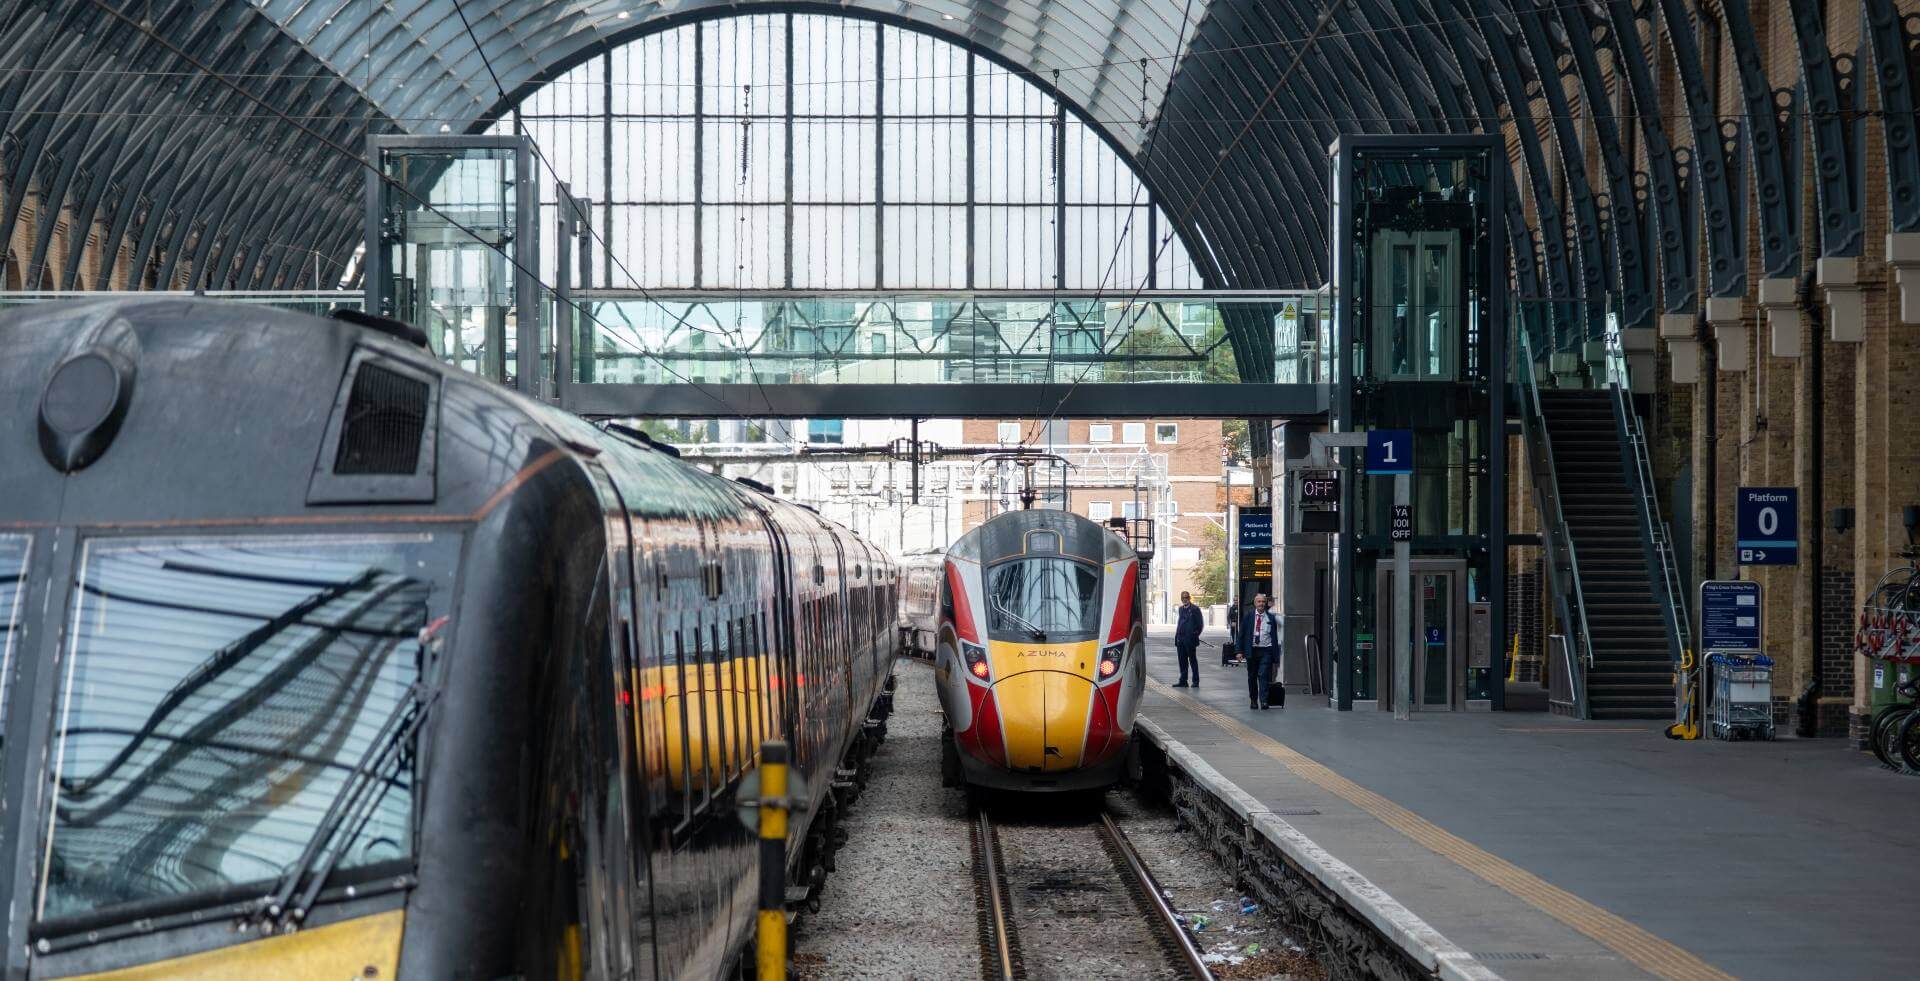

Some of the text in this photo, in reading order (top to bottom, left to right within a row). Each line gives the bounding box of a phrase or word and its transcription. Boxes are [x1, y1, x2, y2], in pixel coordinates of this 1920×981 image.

[1382, 440, 1397, 463] 1
[1304, 481, 1334, 496] OFF
[1748, 492, 1788, 503] Platform
[1395, 508, 1408, 517] YA
[1758, 507, 1778, 536] 0
[1392, 530, 1411, 539] OFF
[1017, 650, 1066, 658] AZUMA
